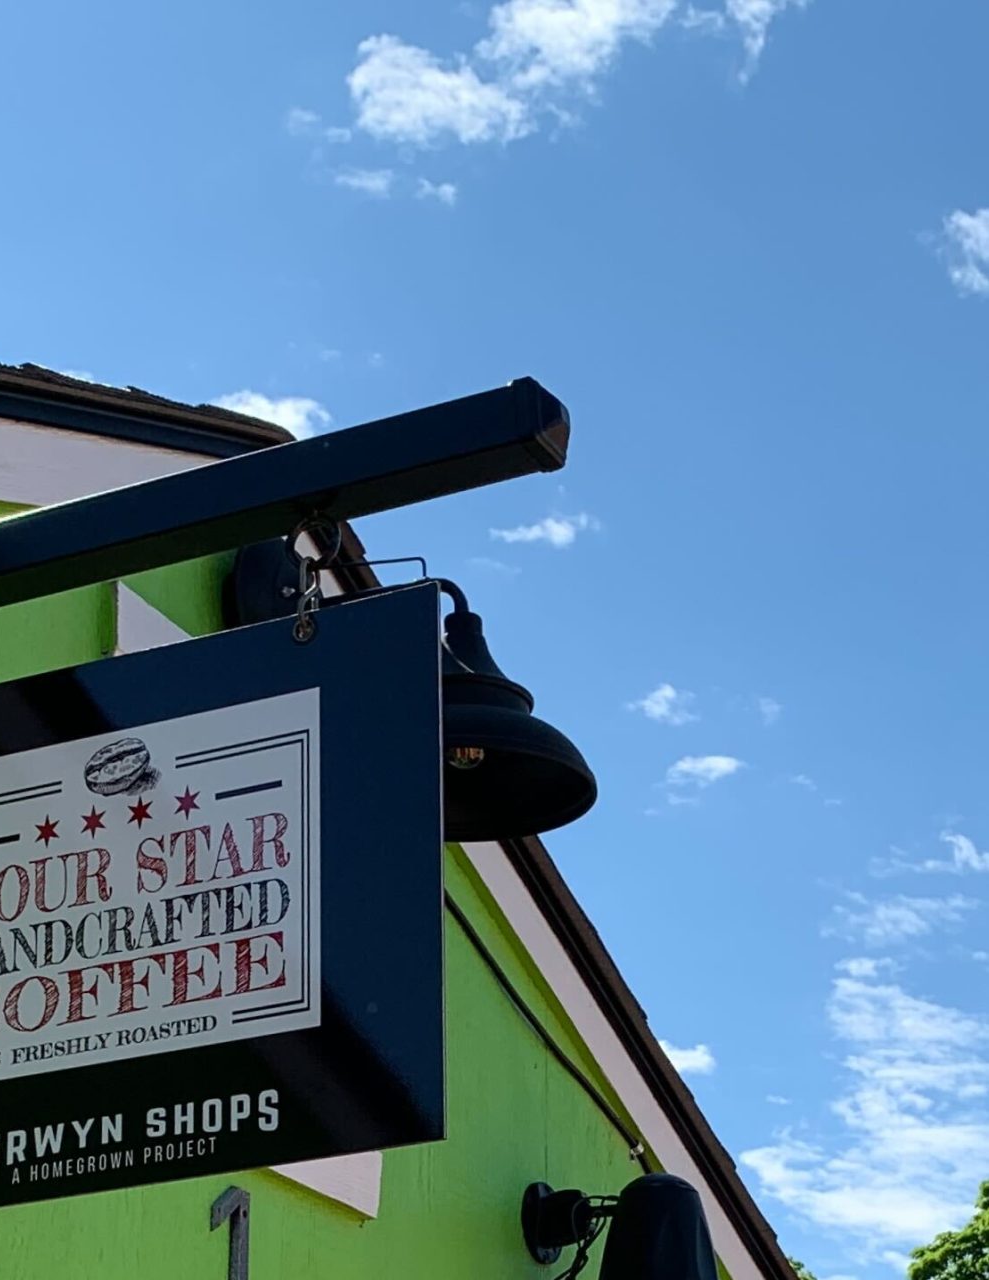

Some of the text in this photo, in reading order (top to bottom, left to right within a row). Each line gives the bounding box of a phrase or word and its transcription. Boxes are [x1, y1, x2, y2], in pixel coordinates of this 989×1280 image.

[135, 811, 291, 895] STAR
[10, 1014, 218, 1065] FRESHLY ROASTED
[146, 1089, 279, 1137] SHOPS
[11, 1136, 218, 1185] A HOMEGROWN PROJECT
